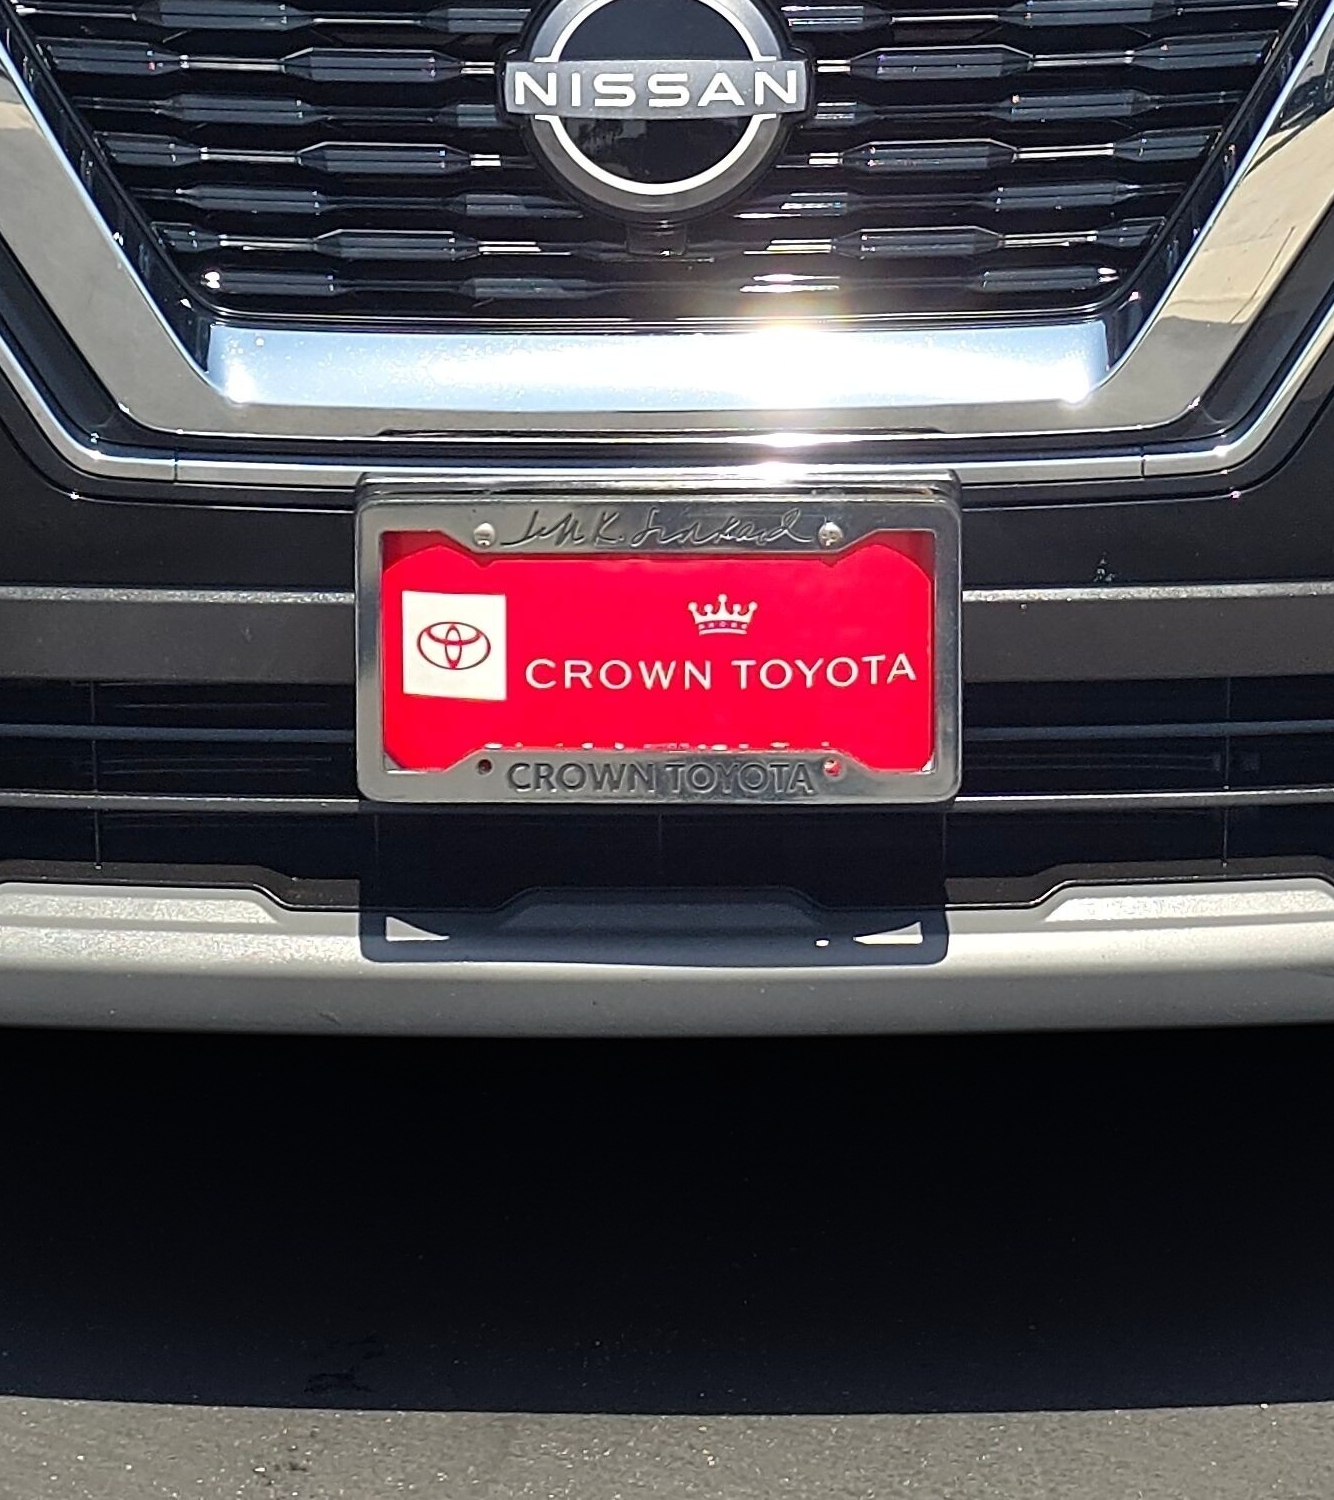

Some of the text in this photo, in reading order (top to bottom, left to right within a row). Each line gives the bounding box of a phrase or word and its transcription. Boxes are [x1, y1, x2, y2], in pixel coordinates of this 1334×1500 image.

[514, 71, 798, 107] NISSAN
[524, 652, 918, 691] CROWN TOYOTA
[506, 760, 815, 796] CROWN TOYOTA
